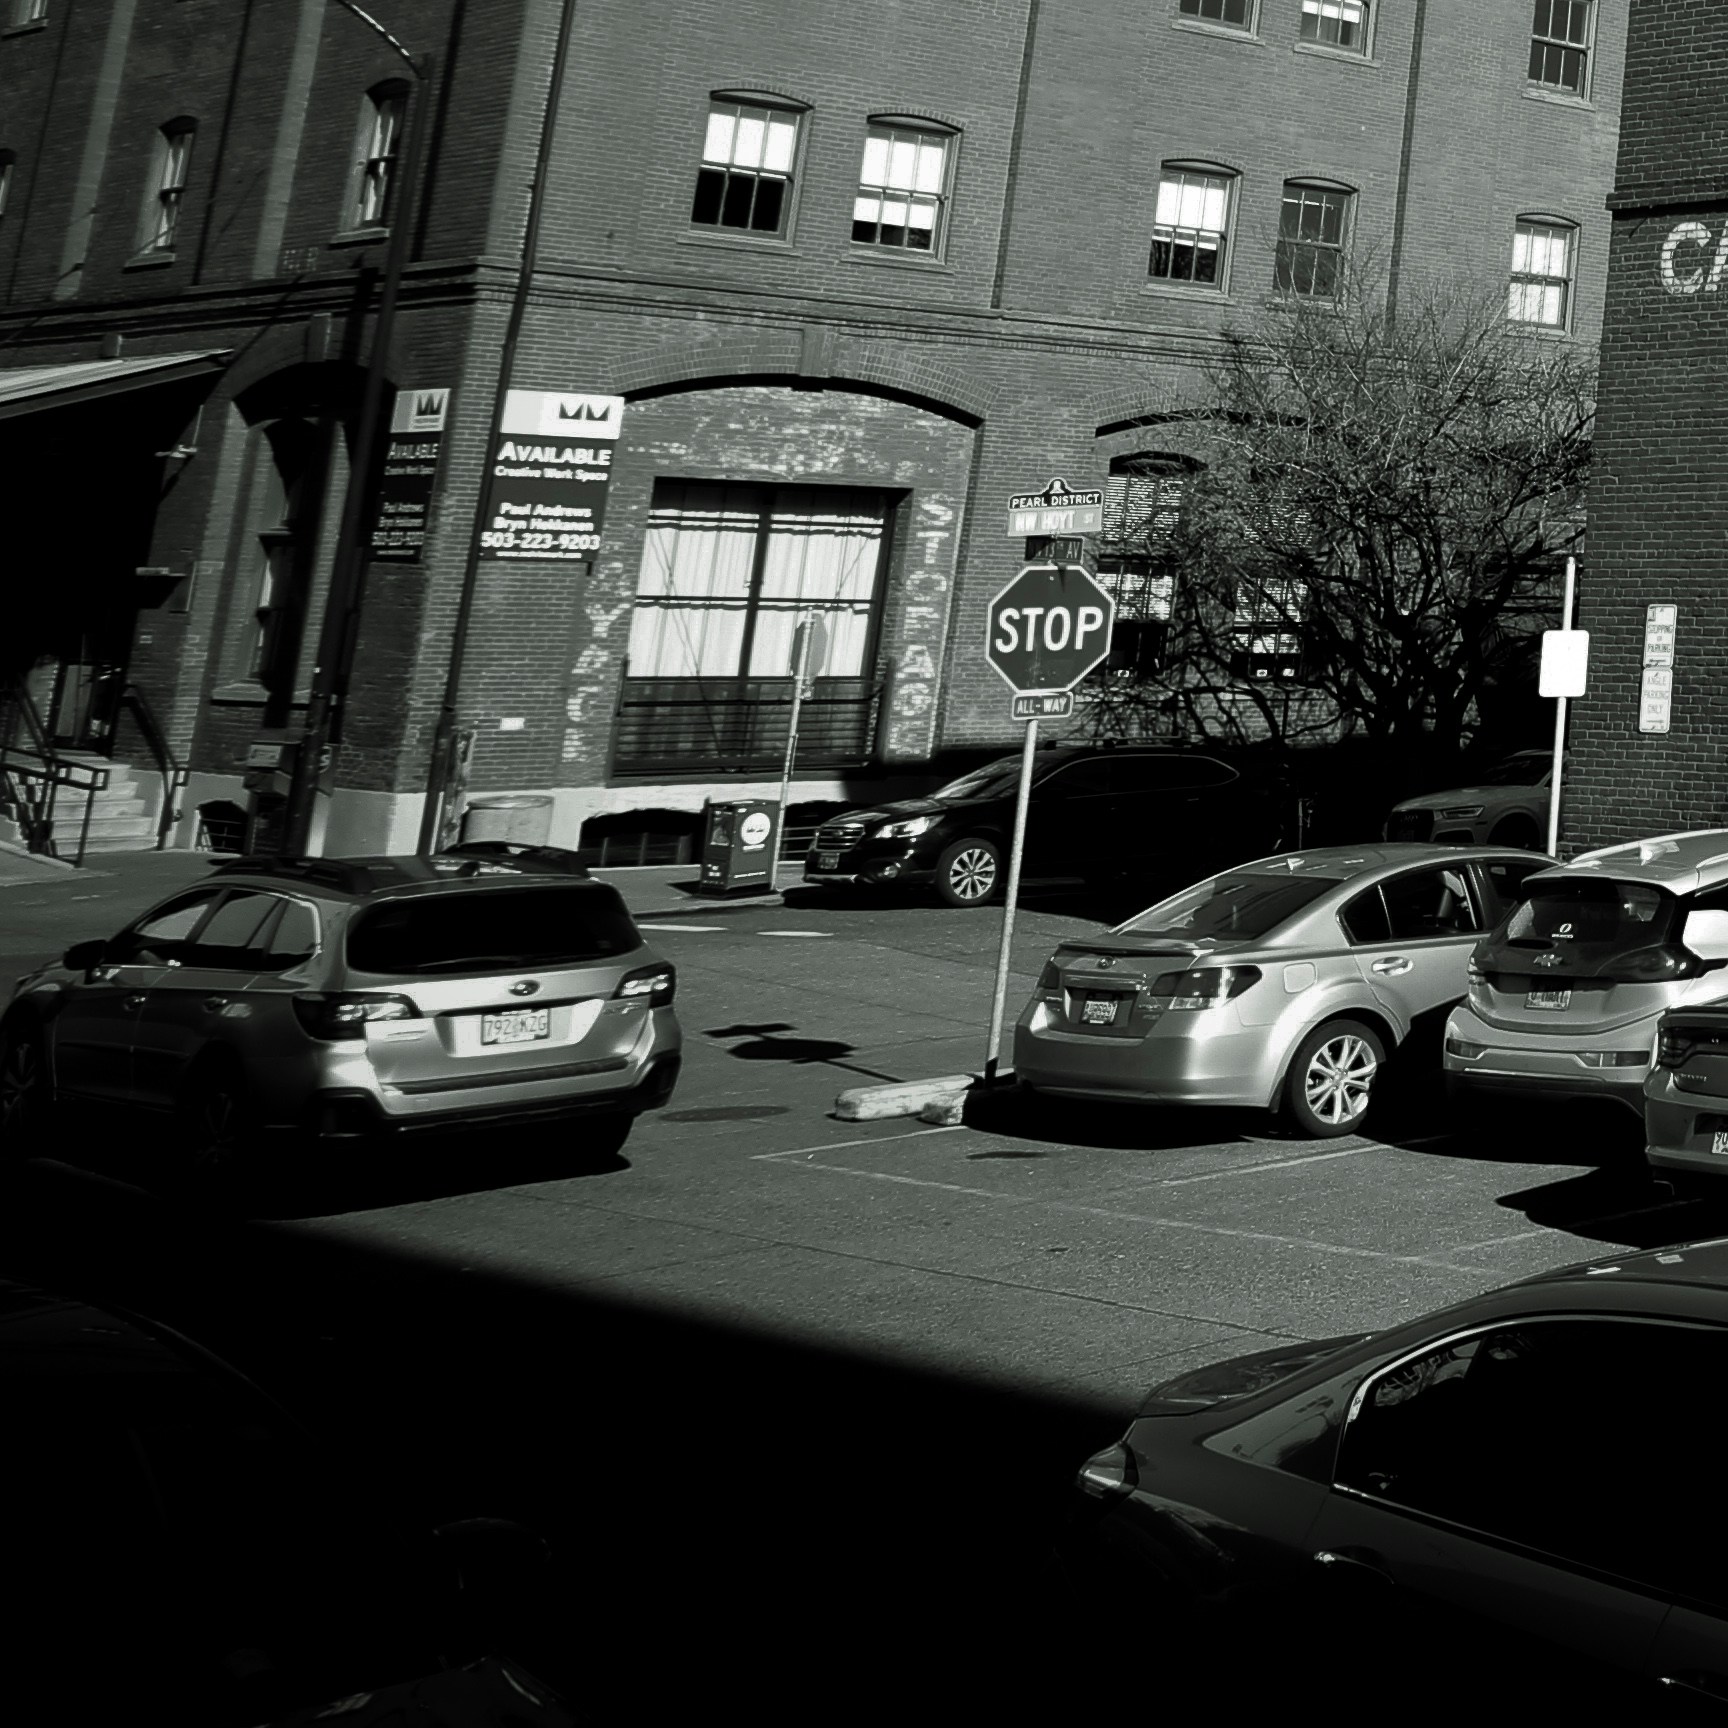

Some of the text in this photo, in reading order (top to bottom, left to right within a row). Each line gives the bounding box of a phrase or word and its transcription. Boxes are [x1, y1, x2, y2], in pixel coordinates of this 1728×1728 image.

[1012, 493, 1100, 509] PEARL DISTRICT
[1015, 511, 1038, 532] NW
[1041, 509, 1076, 530] HOYT
[480, 531, 601, 550] 503-223-9203
[995, 606, 1104, 654] STOP
[1016, 697, 1068, 714] ALL-WAY
[484, 1018, 512, 1036] 792
